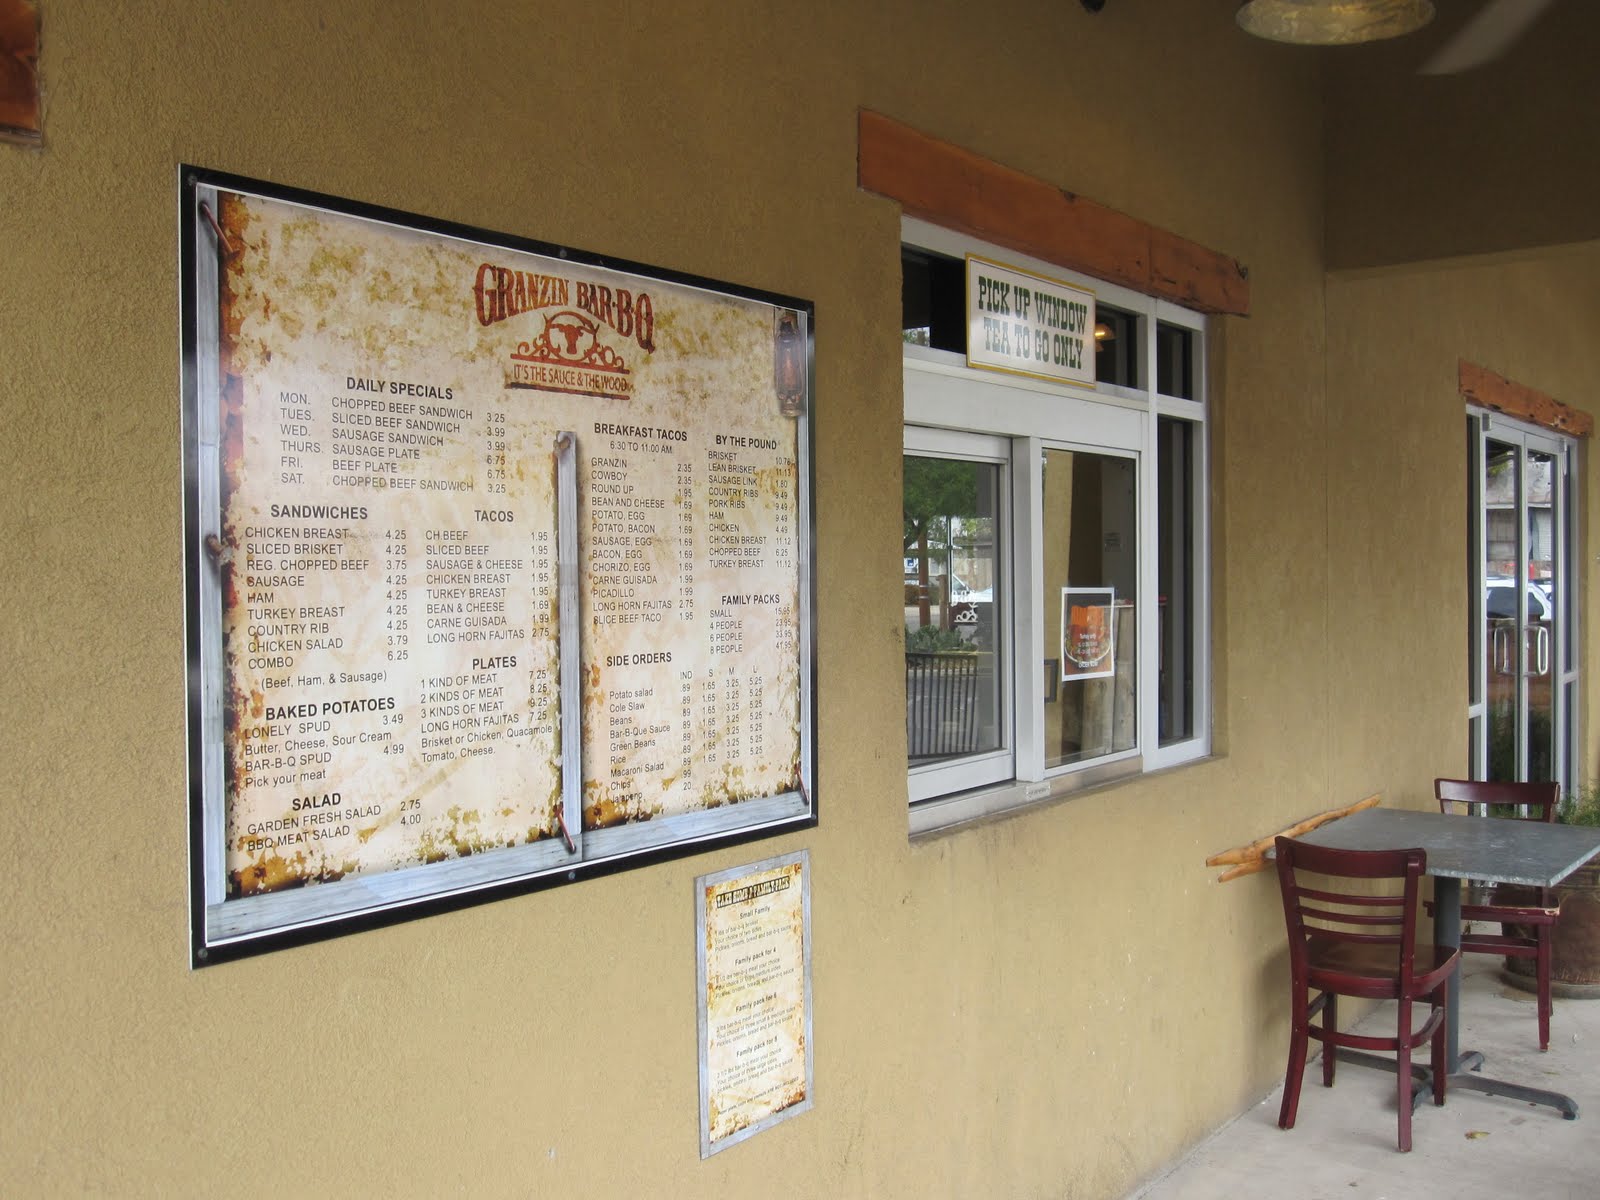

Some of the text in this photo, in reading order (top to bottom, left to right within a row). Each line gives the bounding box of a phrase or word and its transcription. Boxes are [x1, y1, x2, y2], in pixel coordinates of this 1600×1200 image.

[472, 263, 569, 326] GRANZIN
[979, 276, 1087, 335] PICK UP WINDOW
[984, 316, 1083, 369] TEA TO GO ONLY
[514, 364, 627, 391] IT'S THE SAUCE & THE WOOD
[346, 377, 452, 399] DAILY SPECIALS
[280, 392, 505, 423] MON. CHOPPED BEEF SANDWICH 3.25
[281, 408, 505, 437] TUES. SLICED BEEF SANDWICH 3.99
[281, 424, 505, 451] WED. SAUSAGE SANDWICH 3.99
[595, 423, 687, 441] BREAKFAST TACOS
[716, 435, 776, 450] BY THE POUND
[281, 440, 505, 465] THURS. SAUSAGE PLATE 6.75
[281, 457, 505, 479] FRI. BEEF PLATE 6.75
[591, 457, 691, 472] GRANZIN 2.35
[281, 472, 506, 494] SAT. CHOPPED BEEF SANDWICH 3.25
[592, 471, 691, 484] COWBOY 2.35
[709, 487, 741, 496] COUNTRY
[744, 489, 758, 497] RIBS
[271, 504, 368, 519] SANDWICHES
[475, 510, 513, 522] TACOS
[246, 527, 406, 539] CHICKEN BREAST 4.25
[426, 545, 548, 555] SLICED BEEF 1.95
[247, 560, 407, 571] REG. CHOPPED BEEF 3.75
[593, 563, 692, 572] CHORIZO, EGG 1.69
[709, 560, 737, 568] TURKEY
[247, 575, 407, 587] SAUSAGE 4.25
[427, 587, 548, 599] TURKEY BREAST 1.95
[593, 588, 693, 598] PICADILLO 1.99
[722, 594, 780, 605] FAMILY PACKS
[248, 605, 407, 619] TURKEY BREAST 4.25
[710, 609, 732, 617] SMALL
[248, 620, 407, 636] COUNTRY RIB 4.25
[427, 614, 548, 628] CARNE GUISADA 1.99
[248, 635, 408, 652] CHICKEN SALAD 3.79
[248, 650, 408, 669] COMBO 6.25
[473, 656, 517, 670] PLATES
[607, 652, 672, 667] SIDE ORDERS
[262, 670, 387, 691] (Beef, Ham, & Sausage)
[421, 670, 546, 688] 1 KIND OF MEAT 7.25
[610, 690, 632, 699] Potato
[635, 687, 653, 697] salad
[702, 682, 715, 690] 1.65
[726, 679, 739, 687] 3.25
[750, 677, 762, 685] 5.25
[266, 698, 395, 720] BAKED POTATOES
[245, 714, 403, 739] LONELY SPUD 3.49
[245, 732, 392, 756] Butter, Cheese, Sour Cream
[245, 744, 404, 772] BAR-B-Q SPUD 4.99
[422, 753, 457, 763] Tomato,
[246, 769, 326, 788] Pick your meat
[292, 793, 341, 811] SALAD
[248, 799, 420, 835] GARDEN FRESH SALAD 2.75
[248, 814, 421, 851] BBQ MEAT SALAD 4.00
[740, 906, 770, 919] Small Family
